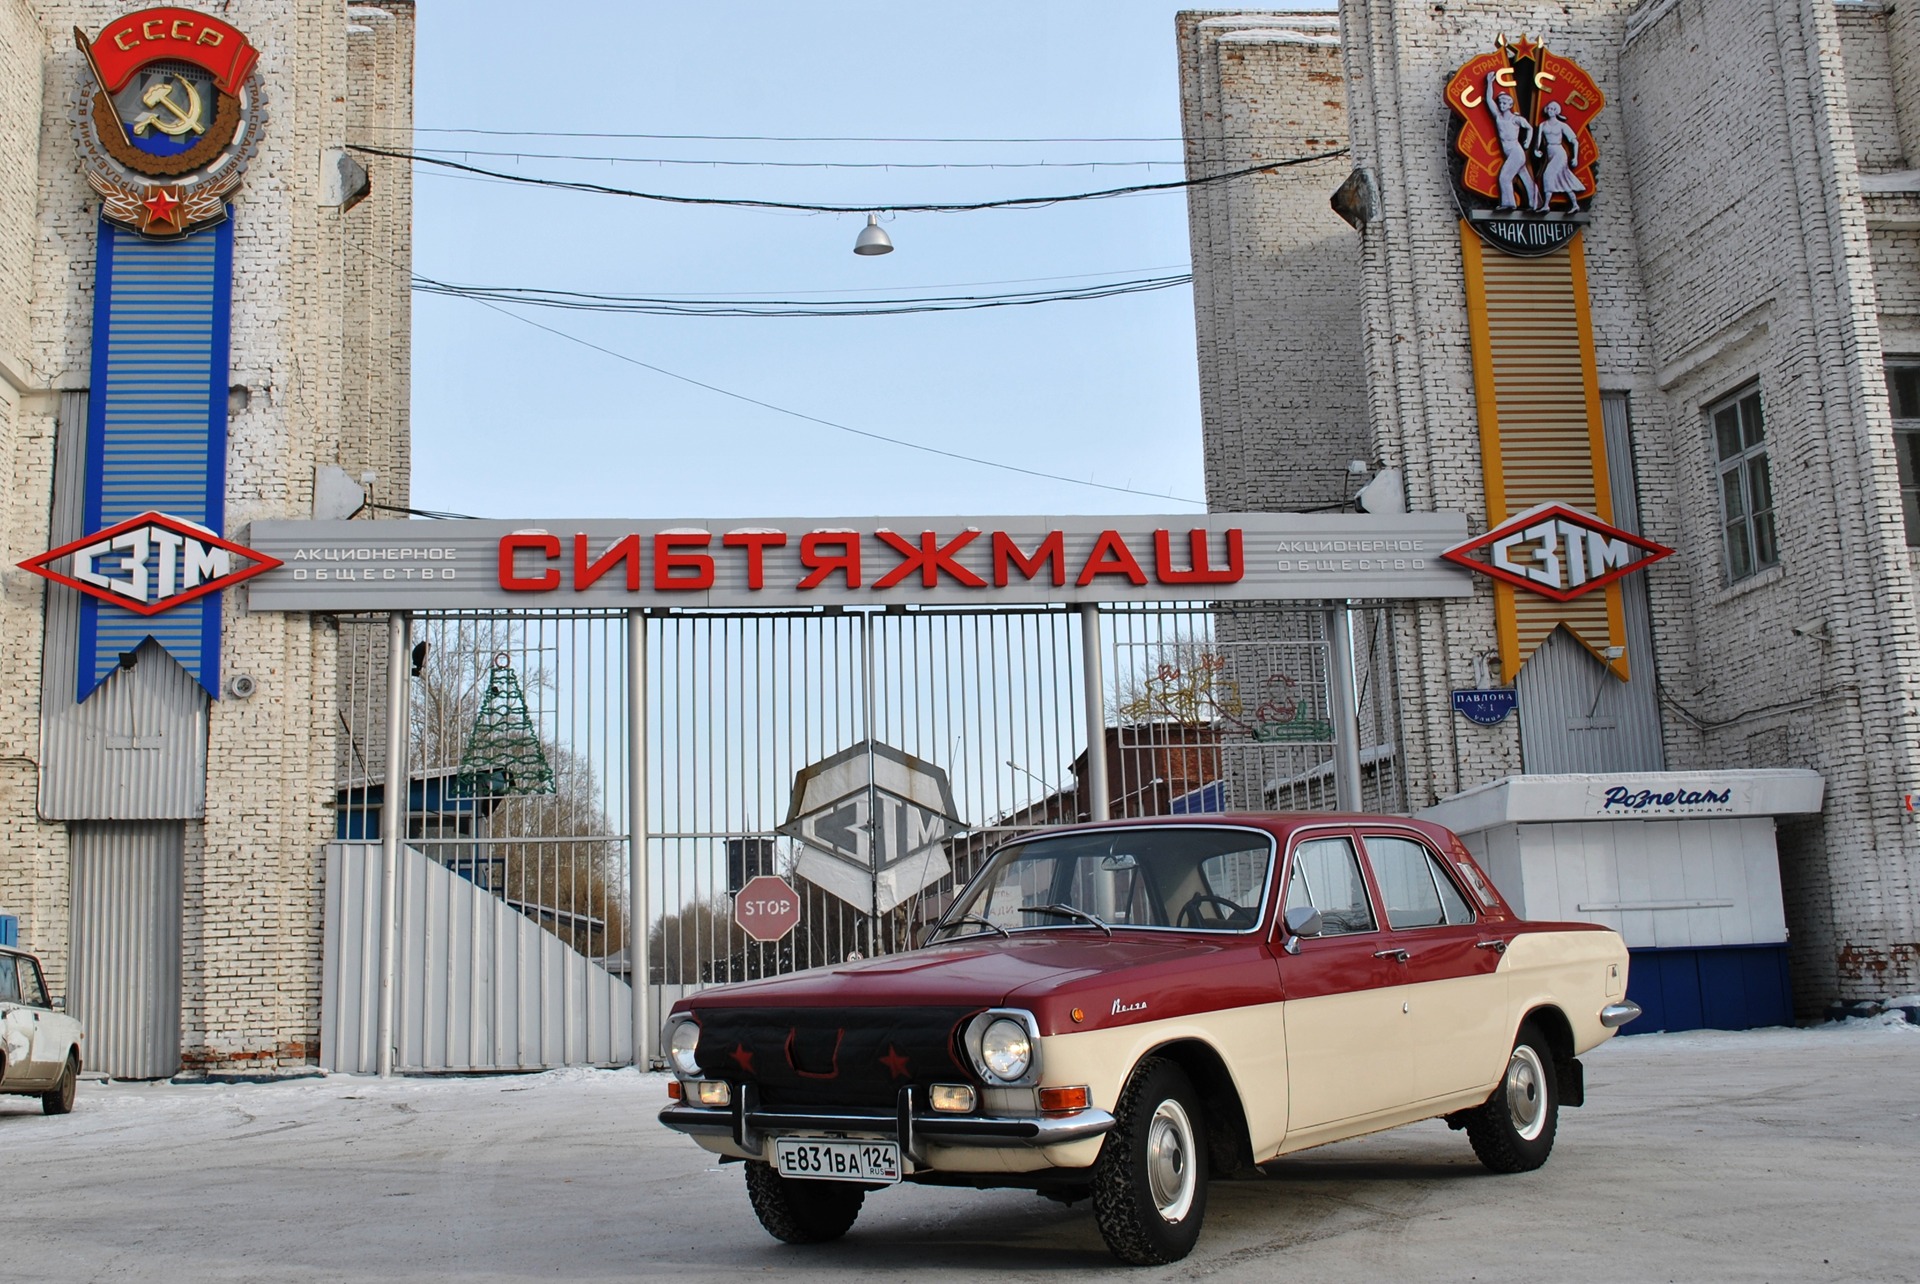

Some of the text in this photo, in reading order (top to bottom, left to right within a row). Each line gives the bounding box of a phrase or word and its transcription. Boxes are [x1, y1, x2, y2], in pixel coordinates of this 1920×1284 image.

[113, 19, 225, 51] СССР
[1450, 56, 1600, 105] ВСЕХ СТРАН, СОЕДИНЯЙ
[1460, 67, 1590, 111] СССР
[78, 79, 139, 194] ПРОЛЕТАРИИ ВСЕХ
[1489, 221, 1574, 245] ЗНАК ПОЧЕТА
[293, 547, 457, 563] АКЦИОНЕРНОЕ
[1277, 540, 1424, 554] АКЦИОНЕРНОЕ
[1492, 518, 1630, 590] СЗТМ
[73, 525, 231, 604] СЗТМ
[497, 528, 1245, 591] СИБТЯЖМАШ
[1277, 557, 1426, 573] ОБЩЕСТВО
[293, 568, 457, 582] ОБЩЕСТВО
[1456, 693, 1513, 703] ПАВЛОВА
[801, 790, 946, 868] СЗТМ
[744, 900, 791, 917] STOP
[862, 1147, 893, 1169] 124
[869, 1167, 885, 1176] RUS
